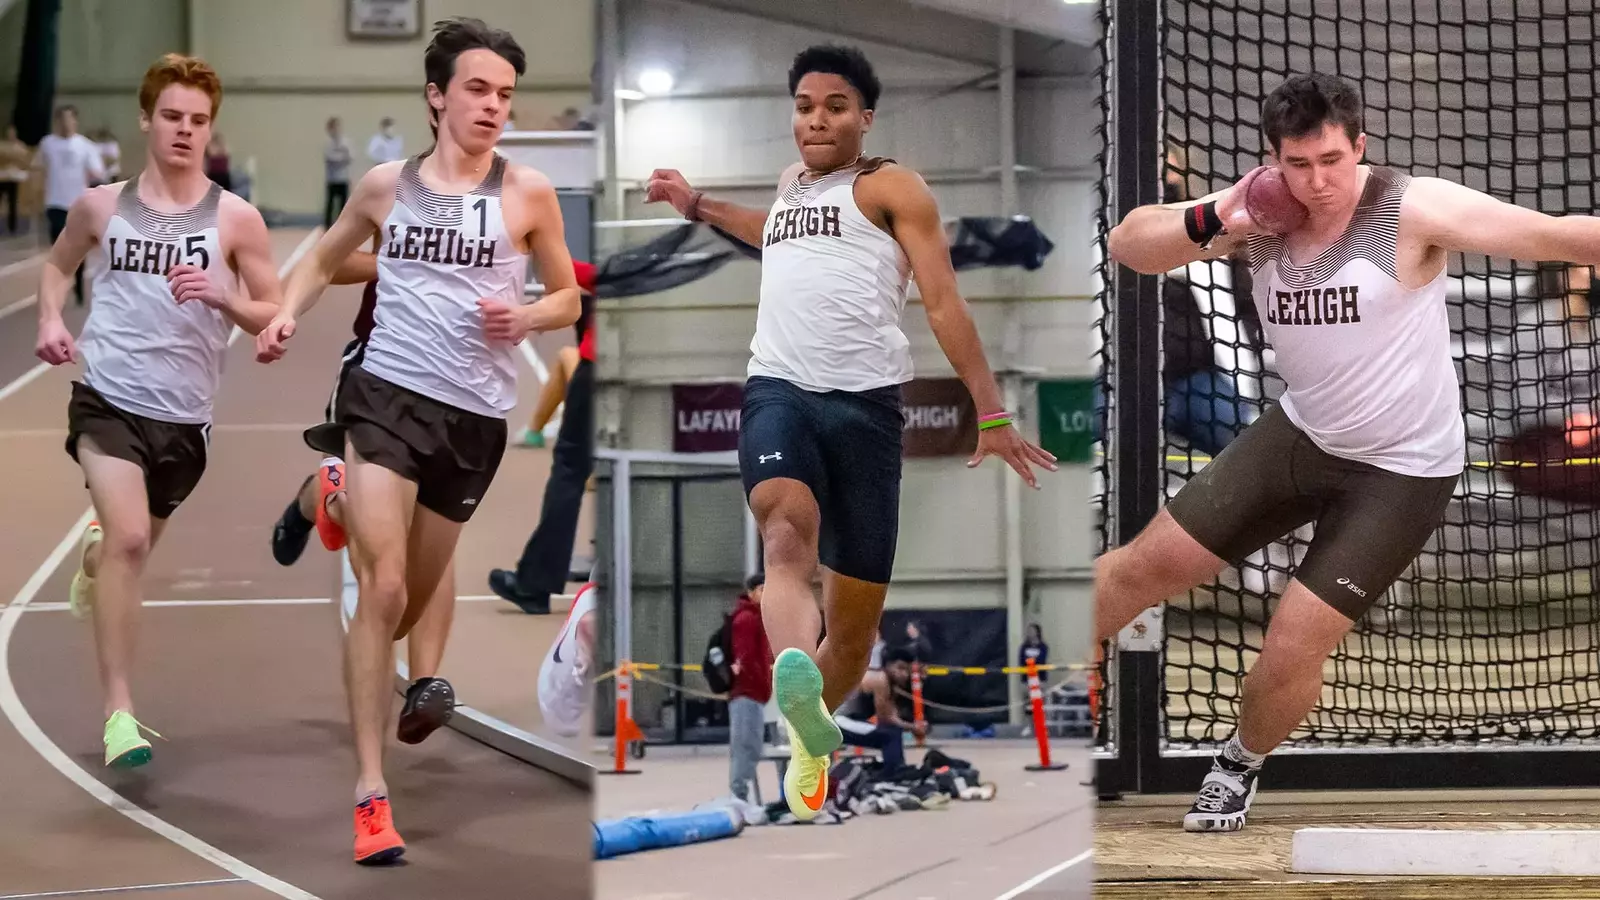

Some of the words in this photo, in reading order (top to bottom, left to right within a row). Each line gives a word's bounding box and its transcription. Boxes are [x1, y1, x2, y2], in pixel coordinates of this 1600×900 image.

[472, 198, 487, 237] 1
[109, 237, 181, 276] LEHI
[185, 235, 210, 271] 5
[1267, 285, 1361, 325] LEHIGH
[1347, 583, 1367, 598] asics
